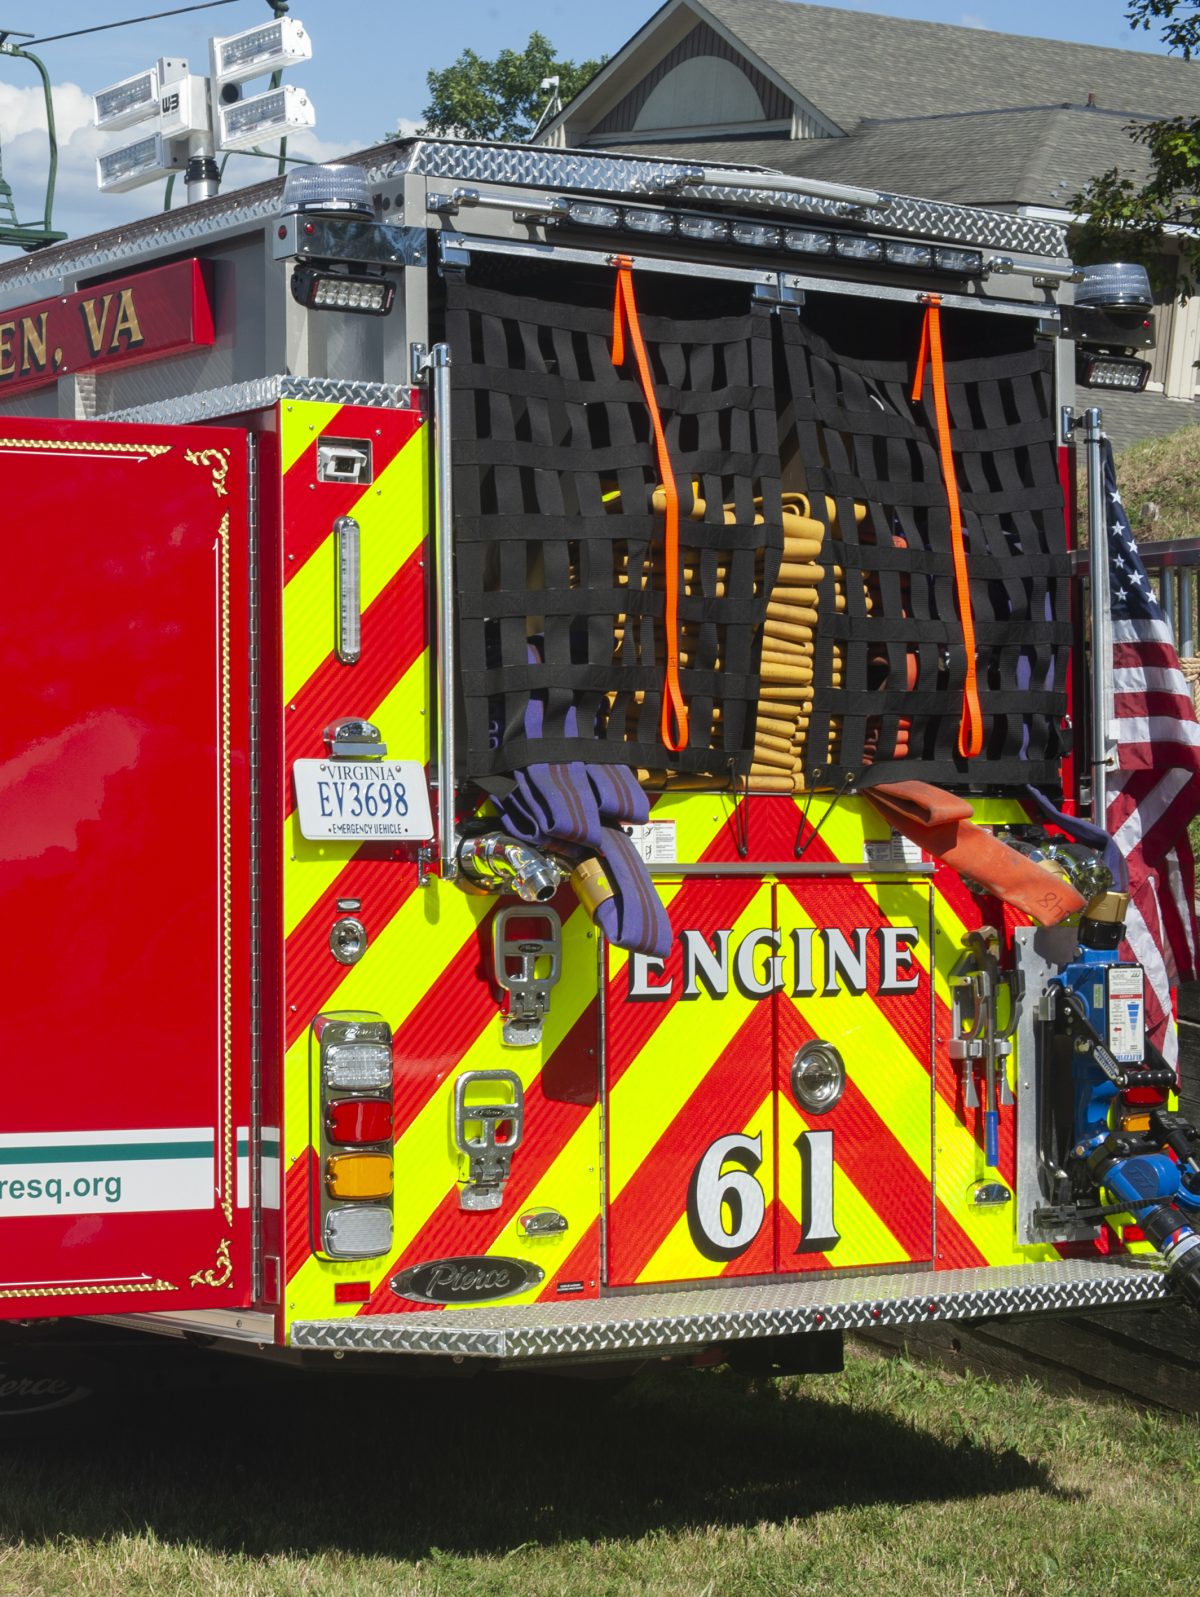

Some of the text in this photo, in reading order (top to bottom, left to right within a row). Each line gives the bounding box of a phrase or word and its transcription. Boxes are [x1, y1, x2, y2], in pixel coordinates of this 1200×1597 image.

[80, 288, 145, 358] VA
[327, 765, 396, 781] VIRGINIA
[317, 781, 409, 818] EV3698
[332, 824, 402, 834] EMERGENCY VEHICLE
[626, 926, 921, 1002] ENGINE
[686, 1129, 841, 1262] 61
[425, 1264, 511, 1297] Pierce
